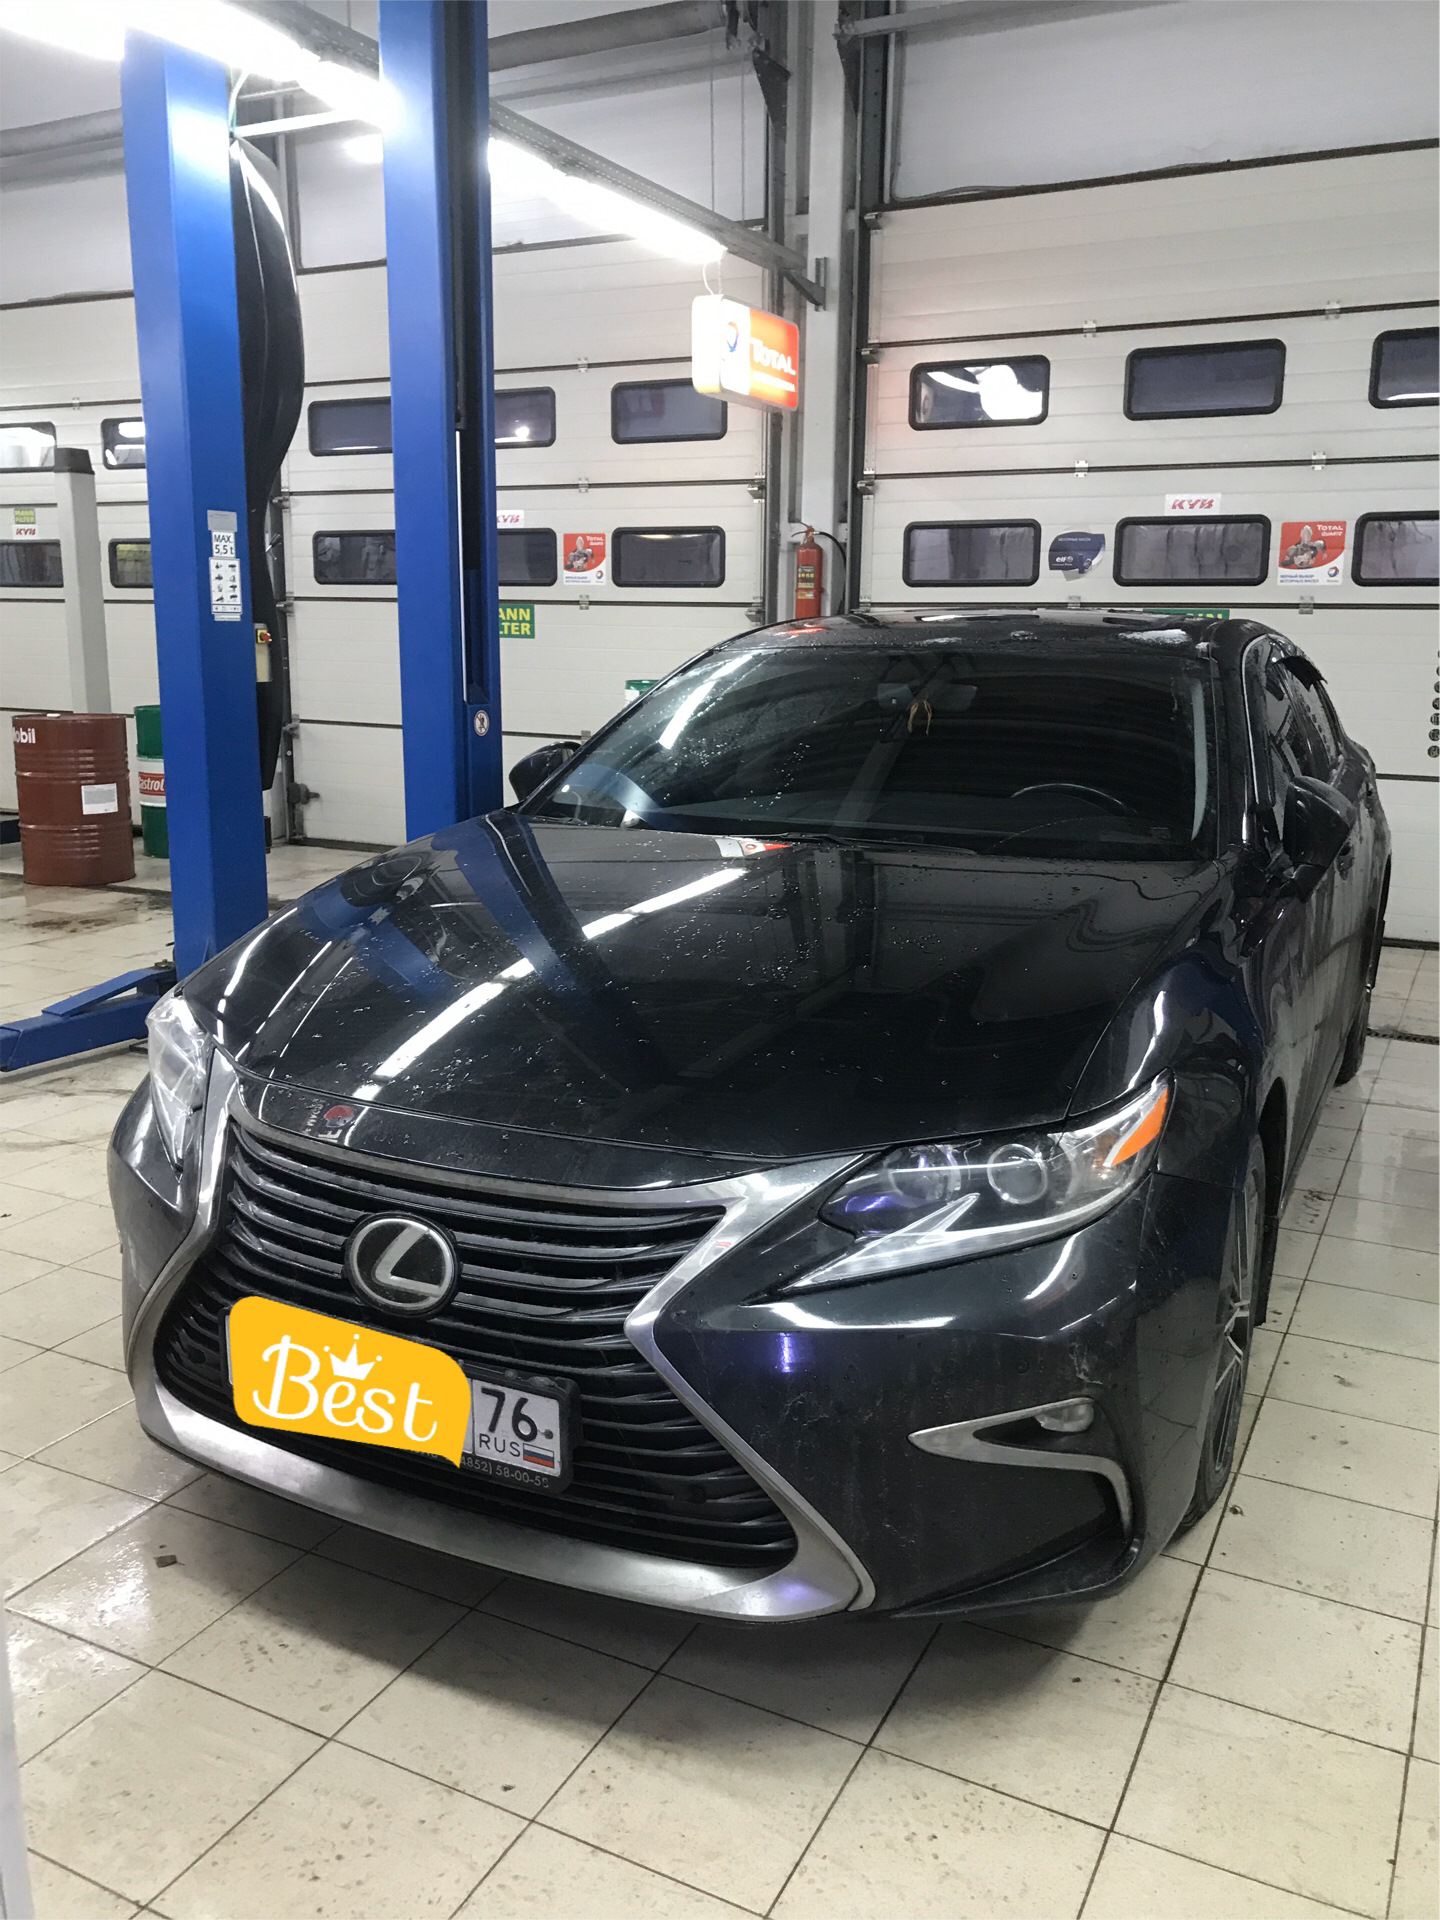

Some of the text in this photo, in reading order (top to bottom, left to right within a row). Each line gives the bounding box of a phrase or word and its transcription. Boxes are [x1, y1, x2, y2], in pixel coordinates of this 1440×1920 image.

[749, 337, 796, 375] TOTAL
[1171, 499, 1214, 510] KYB
[215, 544, 234, 555] 5,5 t
[498, 607, 531, 621] ANN
[499, 622, 531, 635] TER
[12, 727, 36, 744] obil
[138, 776, 164, 791] astrol
[481, 1386, 538, 1442] 76
[479, 1433, 521, 1458] RUS
[460, 1455, 493, 1475] 4852)
